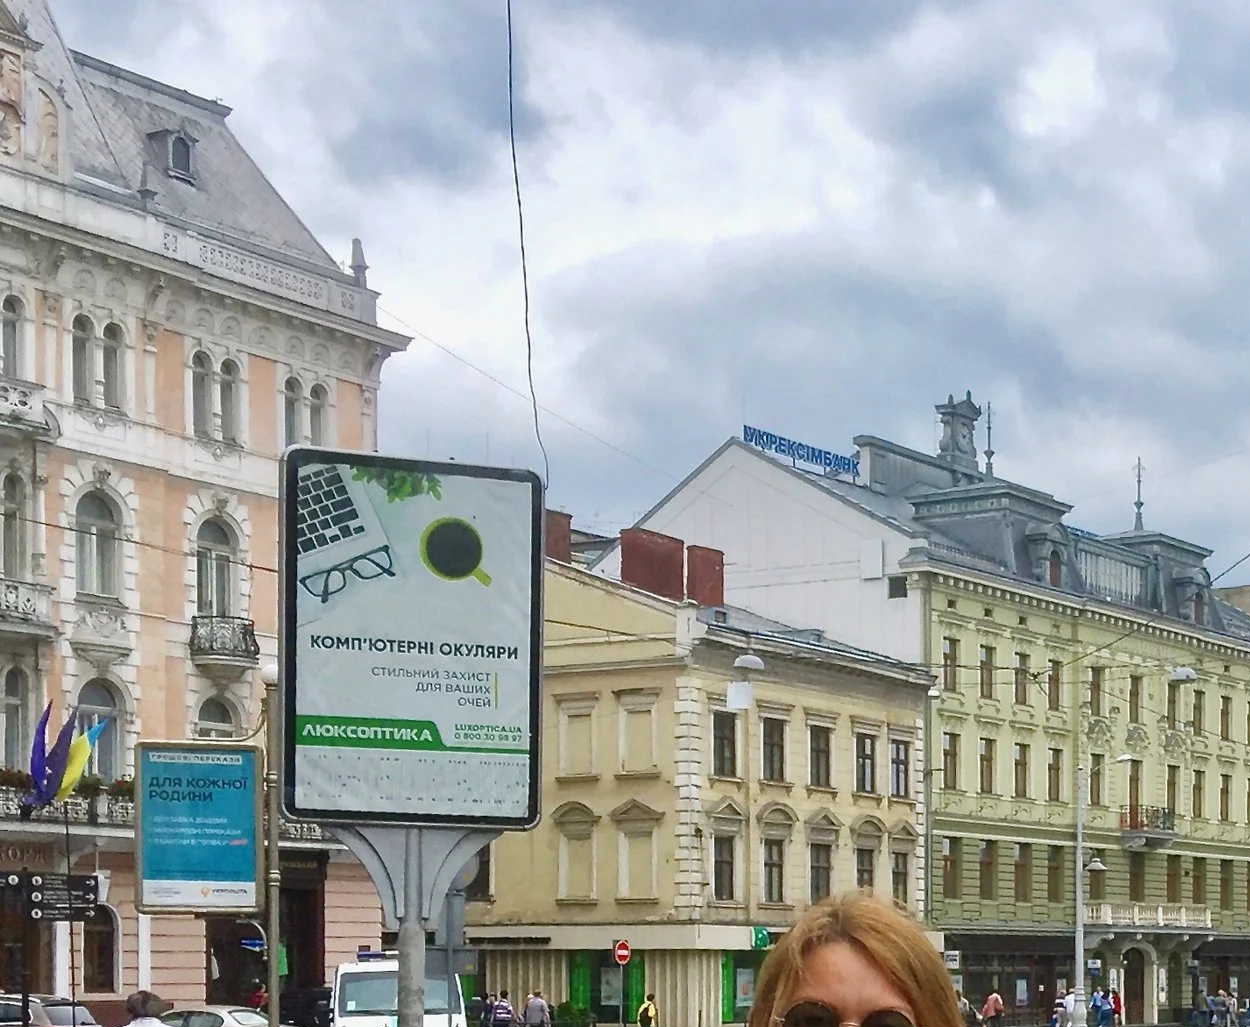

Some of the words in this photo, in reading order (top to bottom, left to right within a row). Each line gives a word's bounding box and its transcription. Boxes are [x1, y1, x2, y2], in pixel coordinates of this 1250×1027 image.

[310, 634, 434, 655] КОМП'ЮТЕРНІ
[439, 643, 518, 660] ОКУЛЯРИ
[371, 666, 440, 679] СТИЛЬНИЙ
[443, 670, 491, 682] ЗАХИСТ
[415, 682, 441, 693] ДЛЯ
[445, 683, 491, 695] ВАШИХ
[457, 696, 491, 708] ОЧЕЙ
[302, 724, 433, 742] ЛЮКСОПТИКА
[455, 723, 522, 733] LUXOPTICA.UA
[149, 777, 182, 788] ДЛЯ
[187, 777, 248, 790] КОЖНОЇ
[149, 790, 213, 803] РОДИНИ
